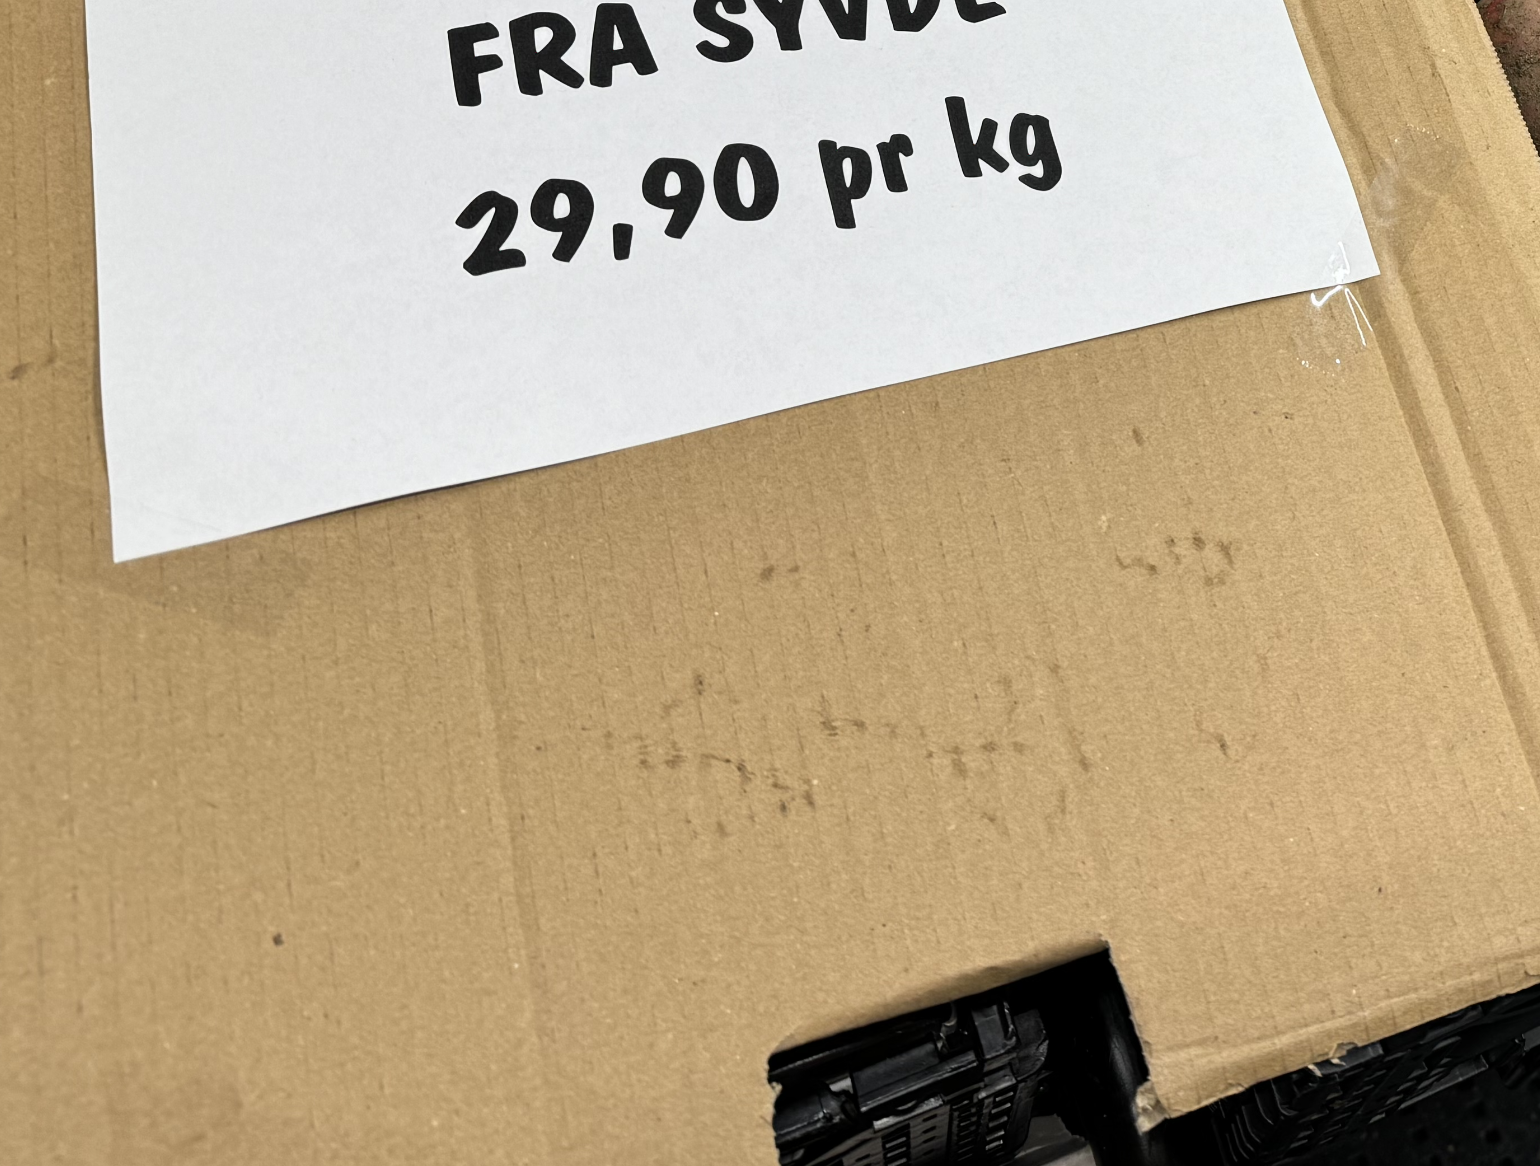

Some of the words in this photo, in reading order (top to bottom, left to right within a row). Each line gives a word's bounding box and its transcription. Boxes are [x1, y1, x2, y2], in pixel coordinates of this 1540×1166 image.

[447, 2, 658, 107] FRA
[455, 143, 779, 276] 29,90
[817, 133, 914, 229] pr
[944, 96, 1062, 191] kg
